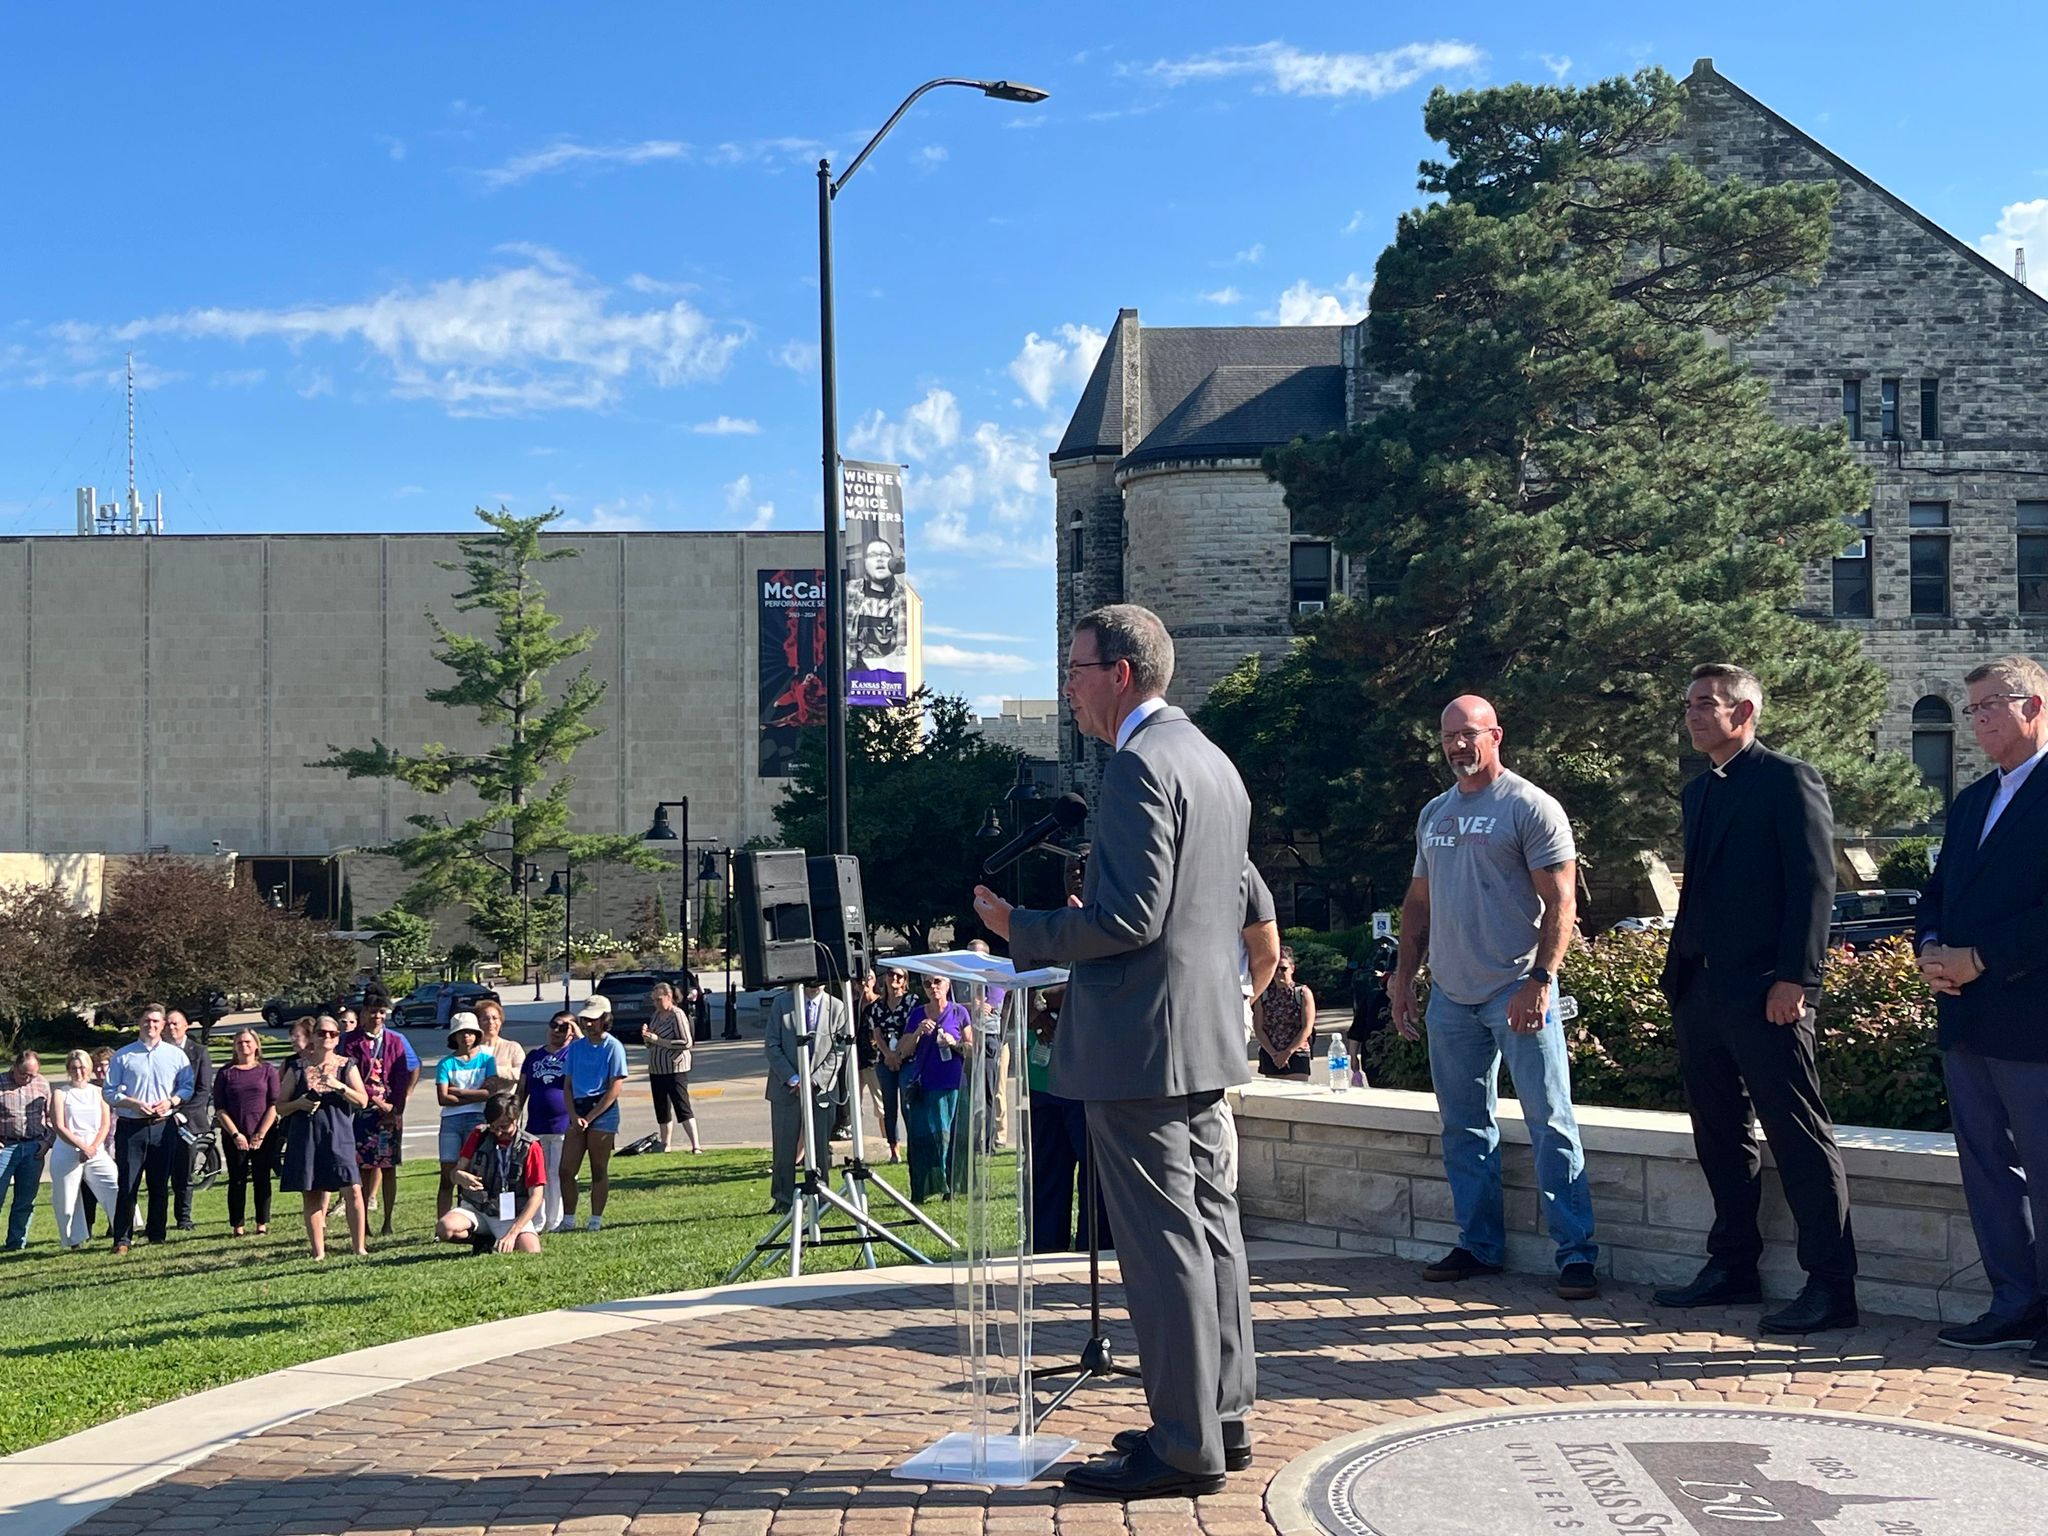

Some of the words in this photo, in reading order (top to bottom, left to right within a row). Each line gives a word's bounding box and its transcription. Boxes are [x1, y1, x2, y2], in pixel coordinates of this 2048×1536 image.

[844, 470, 894, 486] WHERE
[844, 482, 884, 497] YOUR
[845, 495, 889, 510] VOICE
[764, 581, 826, 599] McCai
[764, 600, 815, 608] PERFORMANCE
[851, 680, 880, 689] KANSAS
[880, 680, 902, 690] STATE
[1555, 1442, 1642, 1508] KANSAS
[1806, 1456, 1859, 1480] 1863
[1504, 1442, 1585, 1529] UNIVERS
[1675, 1476, 1786, 1522] 150
[1874, 1519, 1924, 1536] 20
